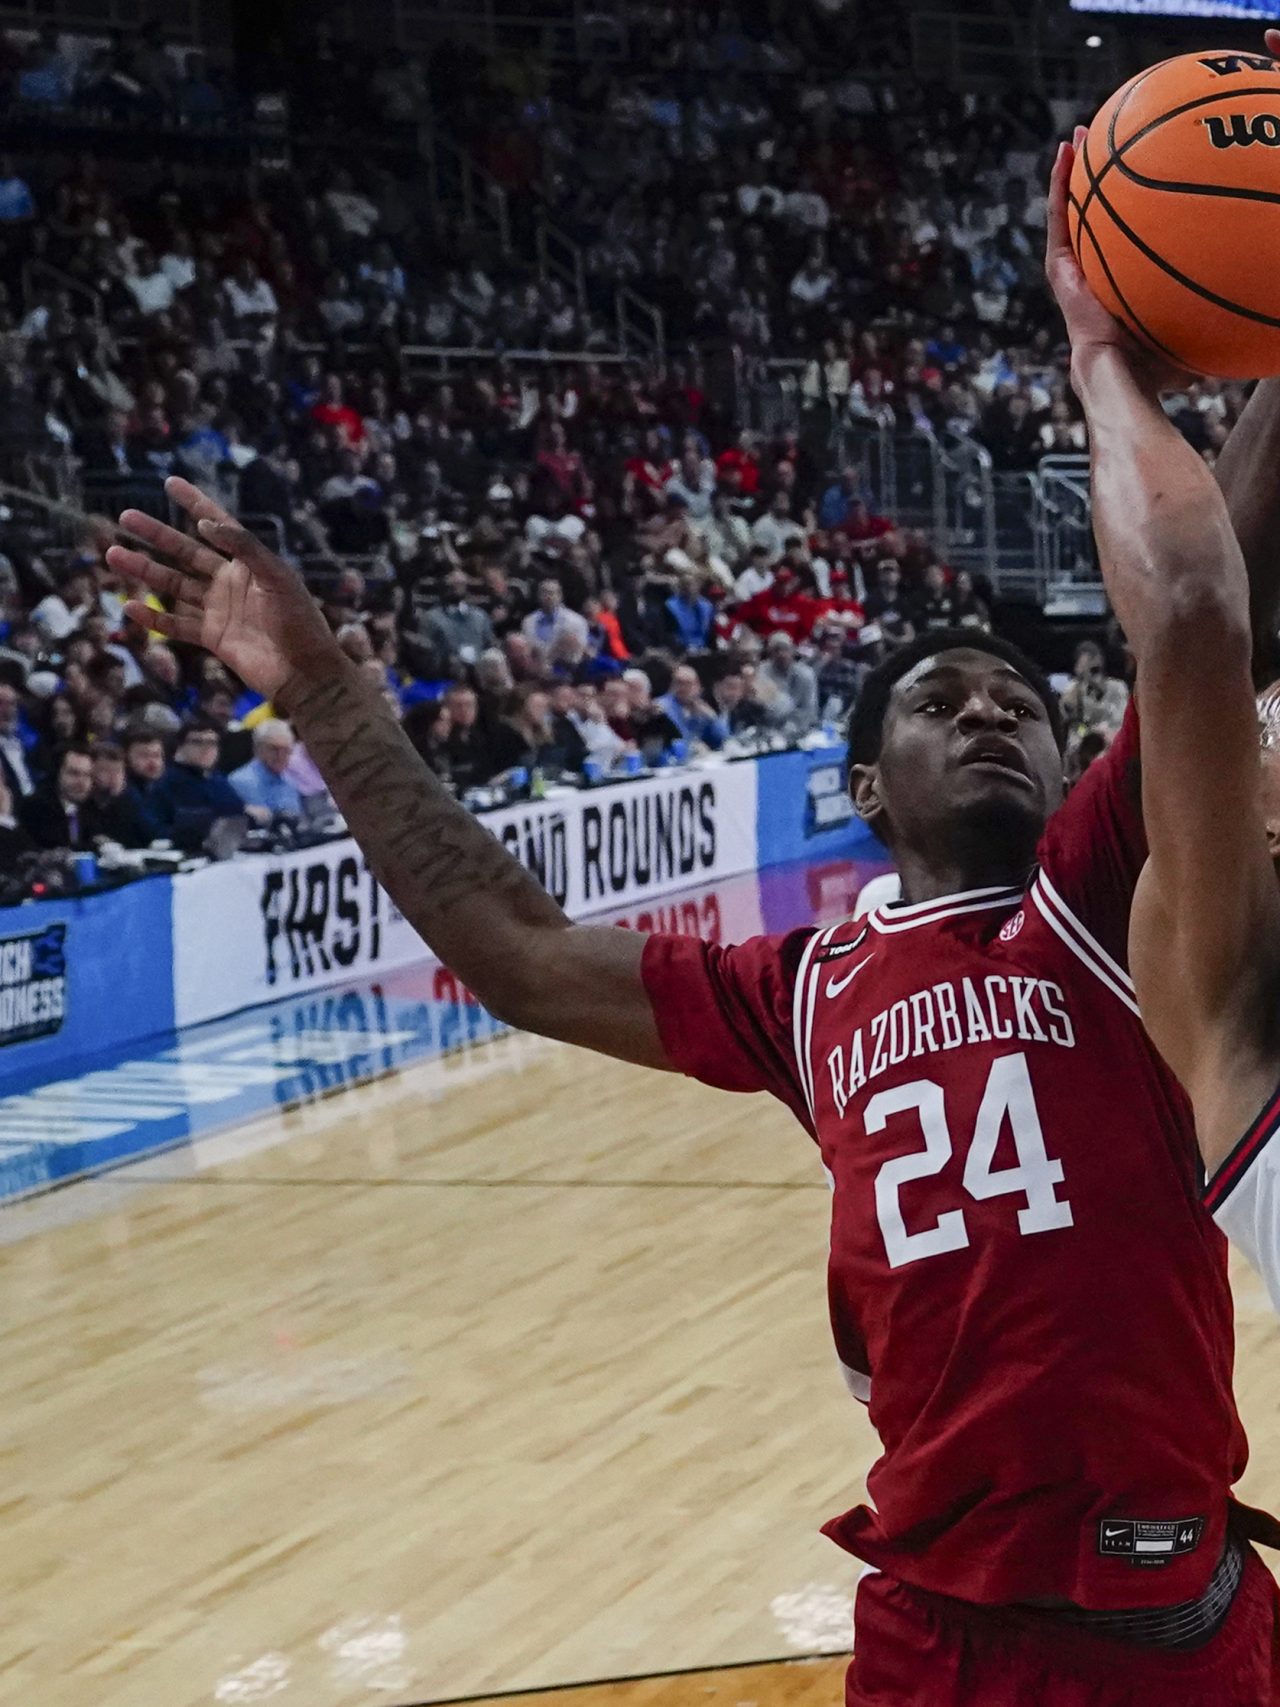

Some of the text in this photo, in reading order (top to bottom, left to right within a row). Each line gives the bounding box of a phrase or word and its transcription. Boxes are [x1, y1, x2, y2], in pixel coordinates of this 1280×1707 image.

[582, 782, 717, 900] ROUNDS
[827, 973, 1076, 1119] RAZORBACKS
[863, 1051, 1075, 1269] 24
[1180, 1528, 1194, 1543] 44
